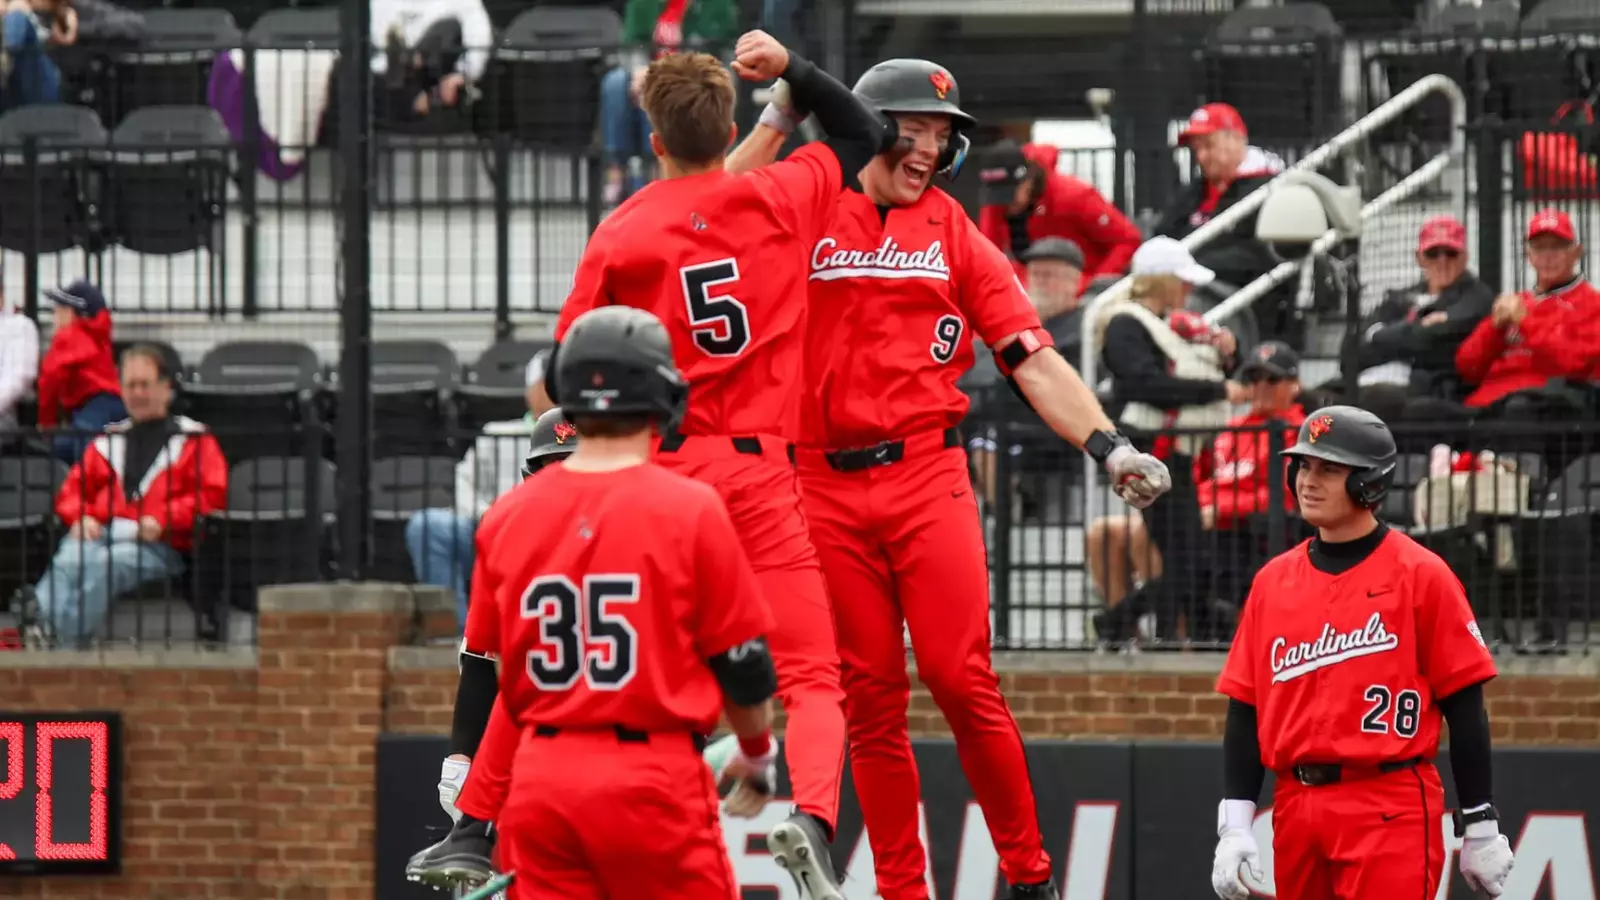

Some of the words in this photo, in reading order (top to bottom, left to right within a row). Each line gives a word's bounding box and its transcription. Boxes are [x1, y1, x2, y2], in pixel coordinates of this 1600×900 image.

[809, 236, 951, 280] Cardinals
[679, 257, 751, 358] 5
[930, 314, 964, 364] 9
[520, 573, 640, 691] 35
[1271, 612, 1398, 684] Cardinals
[1361, 684, 1422, 739] 28
